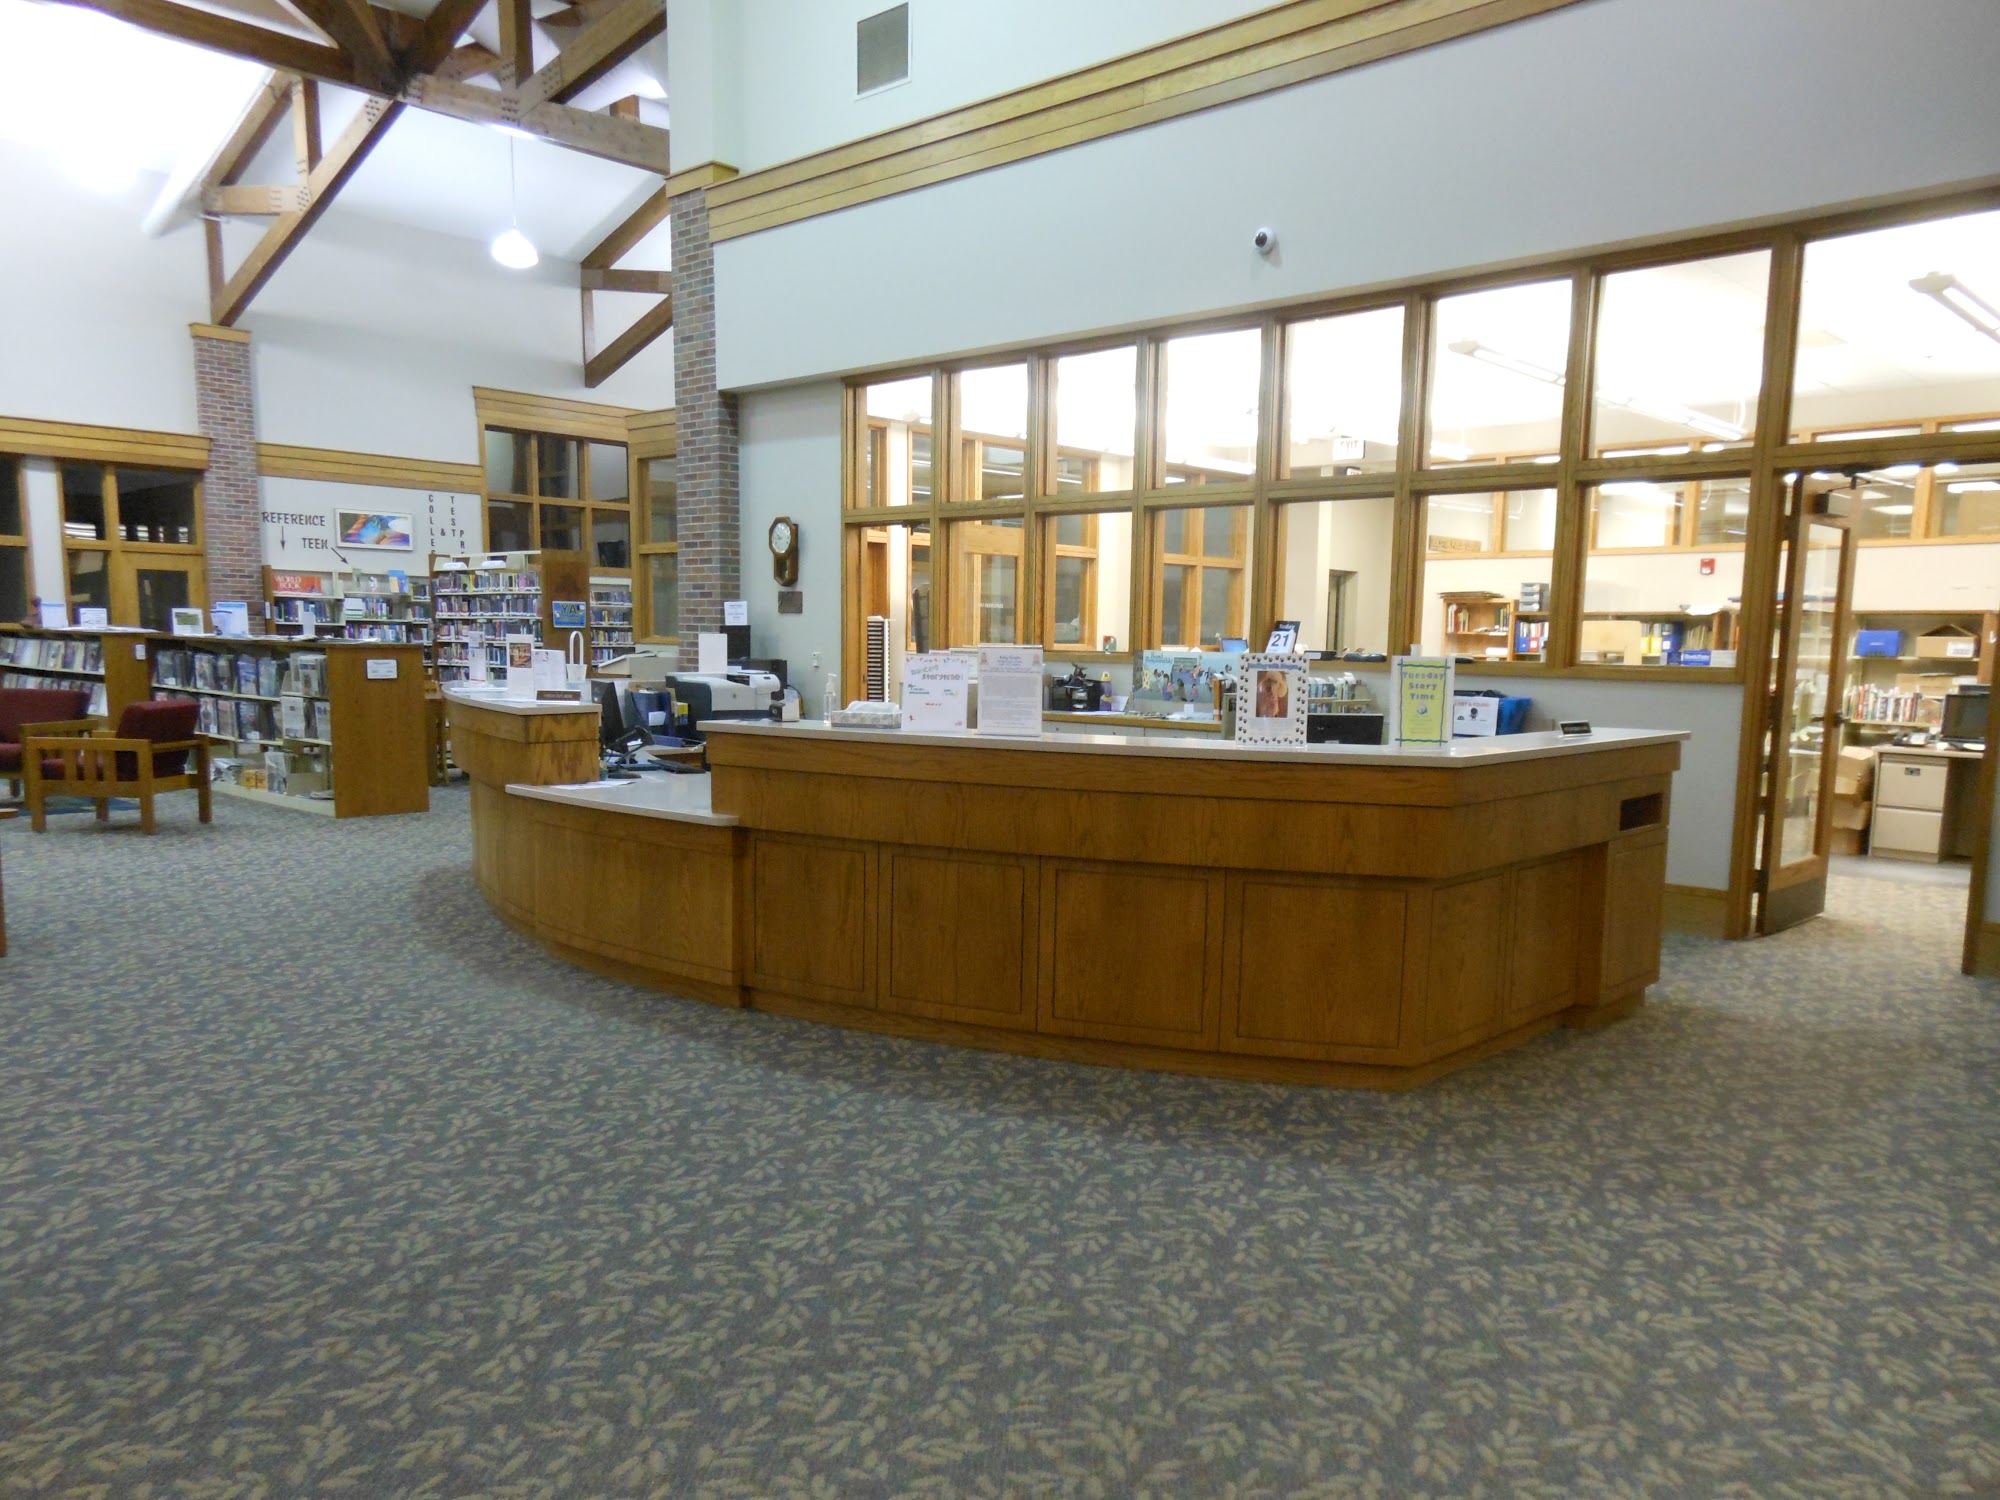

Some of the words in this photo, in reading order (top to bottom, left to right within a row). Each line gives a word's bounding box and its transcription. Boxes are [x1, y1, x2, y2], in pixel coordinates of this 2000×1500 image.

[261, 511, 326, 527] REFERENCE
[440, 528, 446, 536] &
[301, 537, 329, 549] TEEN
[1271, 633, 1290, 648] 21
[1401, 671, 1445, 680] Tuesday
[1409, 682, 1438, 691] Story
